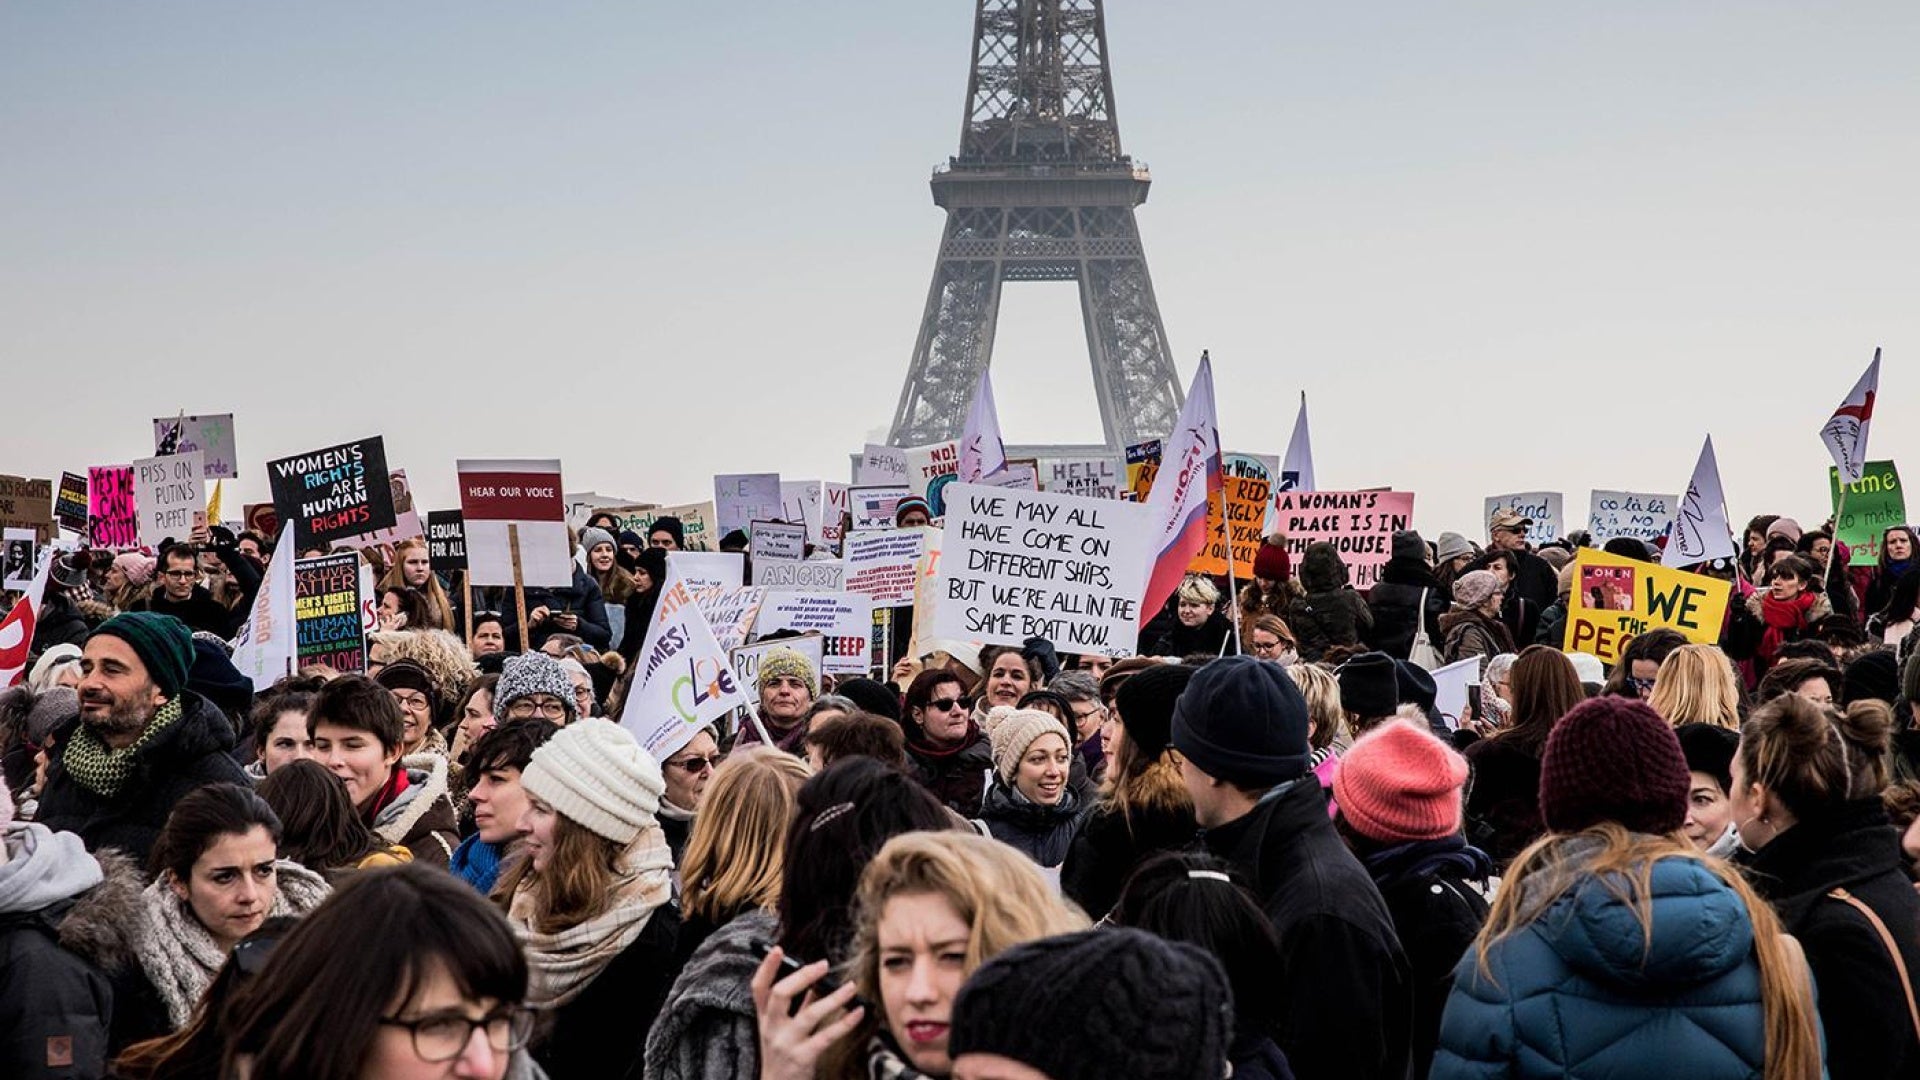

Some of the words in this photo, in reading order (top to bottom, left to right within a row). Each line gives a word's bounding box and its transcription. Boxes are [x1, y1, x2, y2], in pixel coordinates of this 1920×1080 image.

[276, 445, 363, 478] WOMEN'S
[930, 444, 957, 462] NO!
[140, 463, 167, 484] PISS
[174, 461, 192, 480] ON
[304, 461, 365, 490] RIGHTS
[1052, 461, 1114, 480] HELL
[90, 467, 113, 495] YES
[116, 467, 135, 496] WE
[331, 476, 366, 497] ARE
[1066, 477, 1099, 488] HATH
[469, 487, 495, 497] HEAR
[500, 488, 521, 497] OUR
[525, 488, 554, 498] VOICE
[1281, 495, 1293, 510] A
[1300, 493, 1378, 510] WOMAN'S
[100, 496, 128, 519] CAN
[302, 490, 368, 518] HUMAN
[733, 503, 774, 520] THE
[970, 496, 1006, 517] WE
[1015, 501, 1059, 523] MAY
[1065, 508, 1105, 529] ALL
[1864, 501, 1903, 527] make
[155, 508, 187, 530] PUPPET
[311, 505, 370, 534] RIGHTS
[1289, 515, 1340, 531] PLACE
[1350, 514, 1373, 531] IS
[1378, 514, 1407, 532] IN
[1609, 513, 1619, 525] is
[1630, 515, 1654, 527] NO
[89, 515, 138, 548] RESIST!
[431, 523, 463, 538] EQUAL
[961, 521, 1012, 544] HAVE
[1022, 528, 1074, 553] COME
[1080, 537, 1110, 557] ON
[431, 543, 447, 557] FOR
[450, 541, 465, 556] ALL
[320, 564, 356, 579] LIVES
[761, 564, 844, 589] ANGRY
[1583, 568, 1631, 579] WOMEN
[296, 574, 356, 595] ATTER
[296, 596, 321, 609] MEN'S
[324, 591, 355, 606] RIGHTS
[328, 603, 356, 615] RIGHTS
[949, 577, 985, 601] BUT
[992, 585, 1046, 610] WE'RE
[1050, 592, 1082, 614] ALL
[1109, 597, 1136, 621] THE
[1646, 576, 1707, 629] WE
[304, 615, 358, 631] HUMAN
[965, 607, 1015, 635] SAME
[1022, 614, 1067, 640] BOAT
[1070, 621, 1109, 646] NOW.
[1617, 617, 1648, 635] THE
[299, 627, 360, 645] ILLEGAL
[331, 649, 363, 672] LOVE
